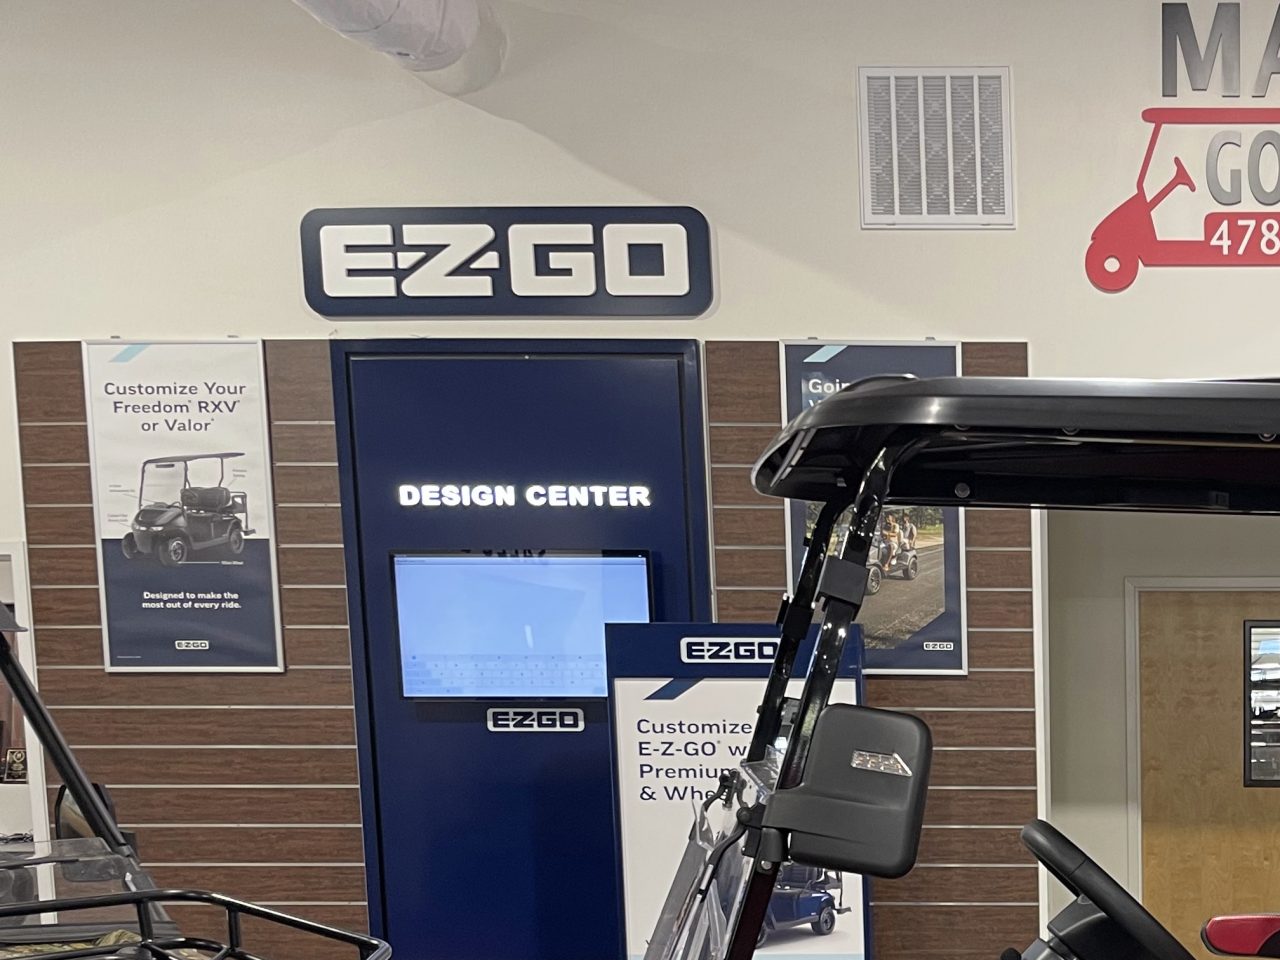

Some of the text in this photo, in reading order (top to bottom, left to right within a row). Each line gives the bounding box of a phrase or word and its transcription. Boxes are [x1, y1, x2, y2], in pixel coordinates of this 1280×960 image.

[104, 382, 246, 395] Customize Your
[141, 422, 159, 431] or
[399, 485, 651, 506] DESIGN CENTER
[143, 592, 184, 600] Designed
[637, 719, 753, 734] Customize
[640, 785, 656, 801] &
